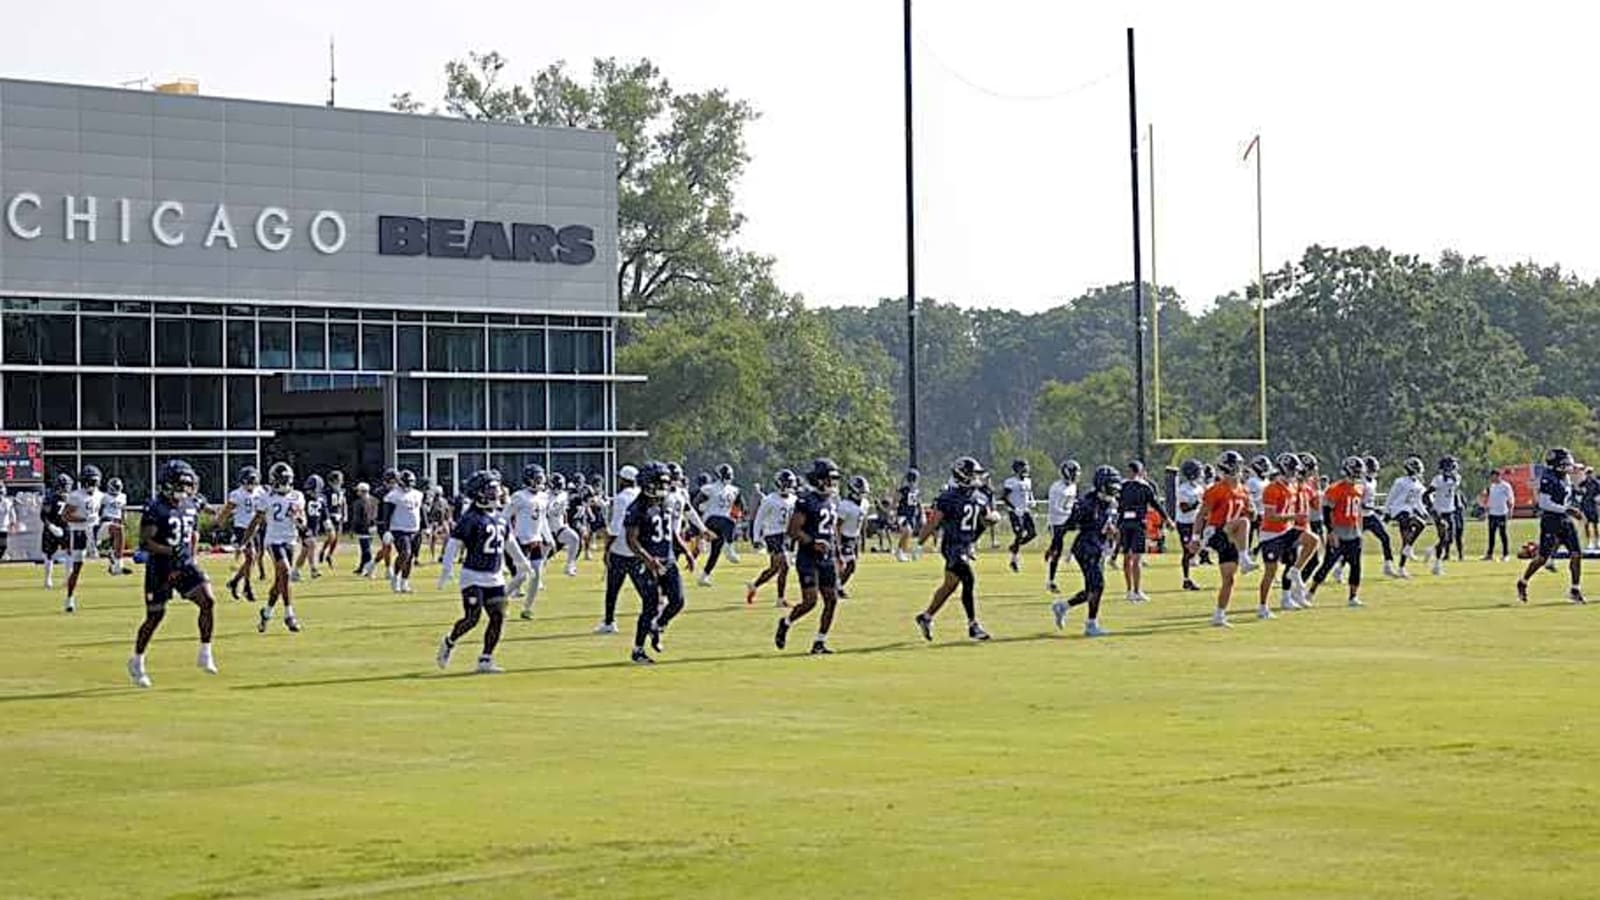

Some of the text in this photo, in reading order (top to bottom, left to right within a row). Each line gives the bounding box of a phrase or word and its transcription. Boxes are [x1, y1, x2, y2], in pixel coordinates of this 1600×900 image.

[7, 192, 596, 265] CHICAGO BEARS
[167, 516, 195, 545] 35
[651, 513, 673, 543] 33
[960, 504, 981, 531] 21
[483, 524, 506, 554] 25
